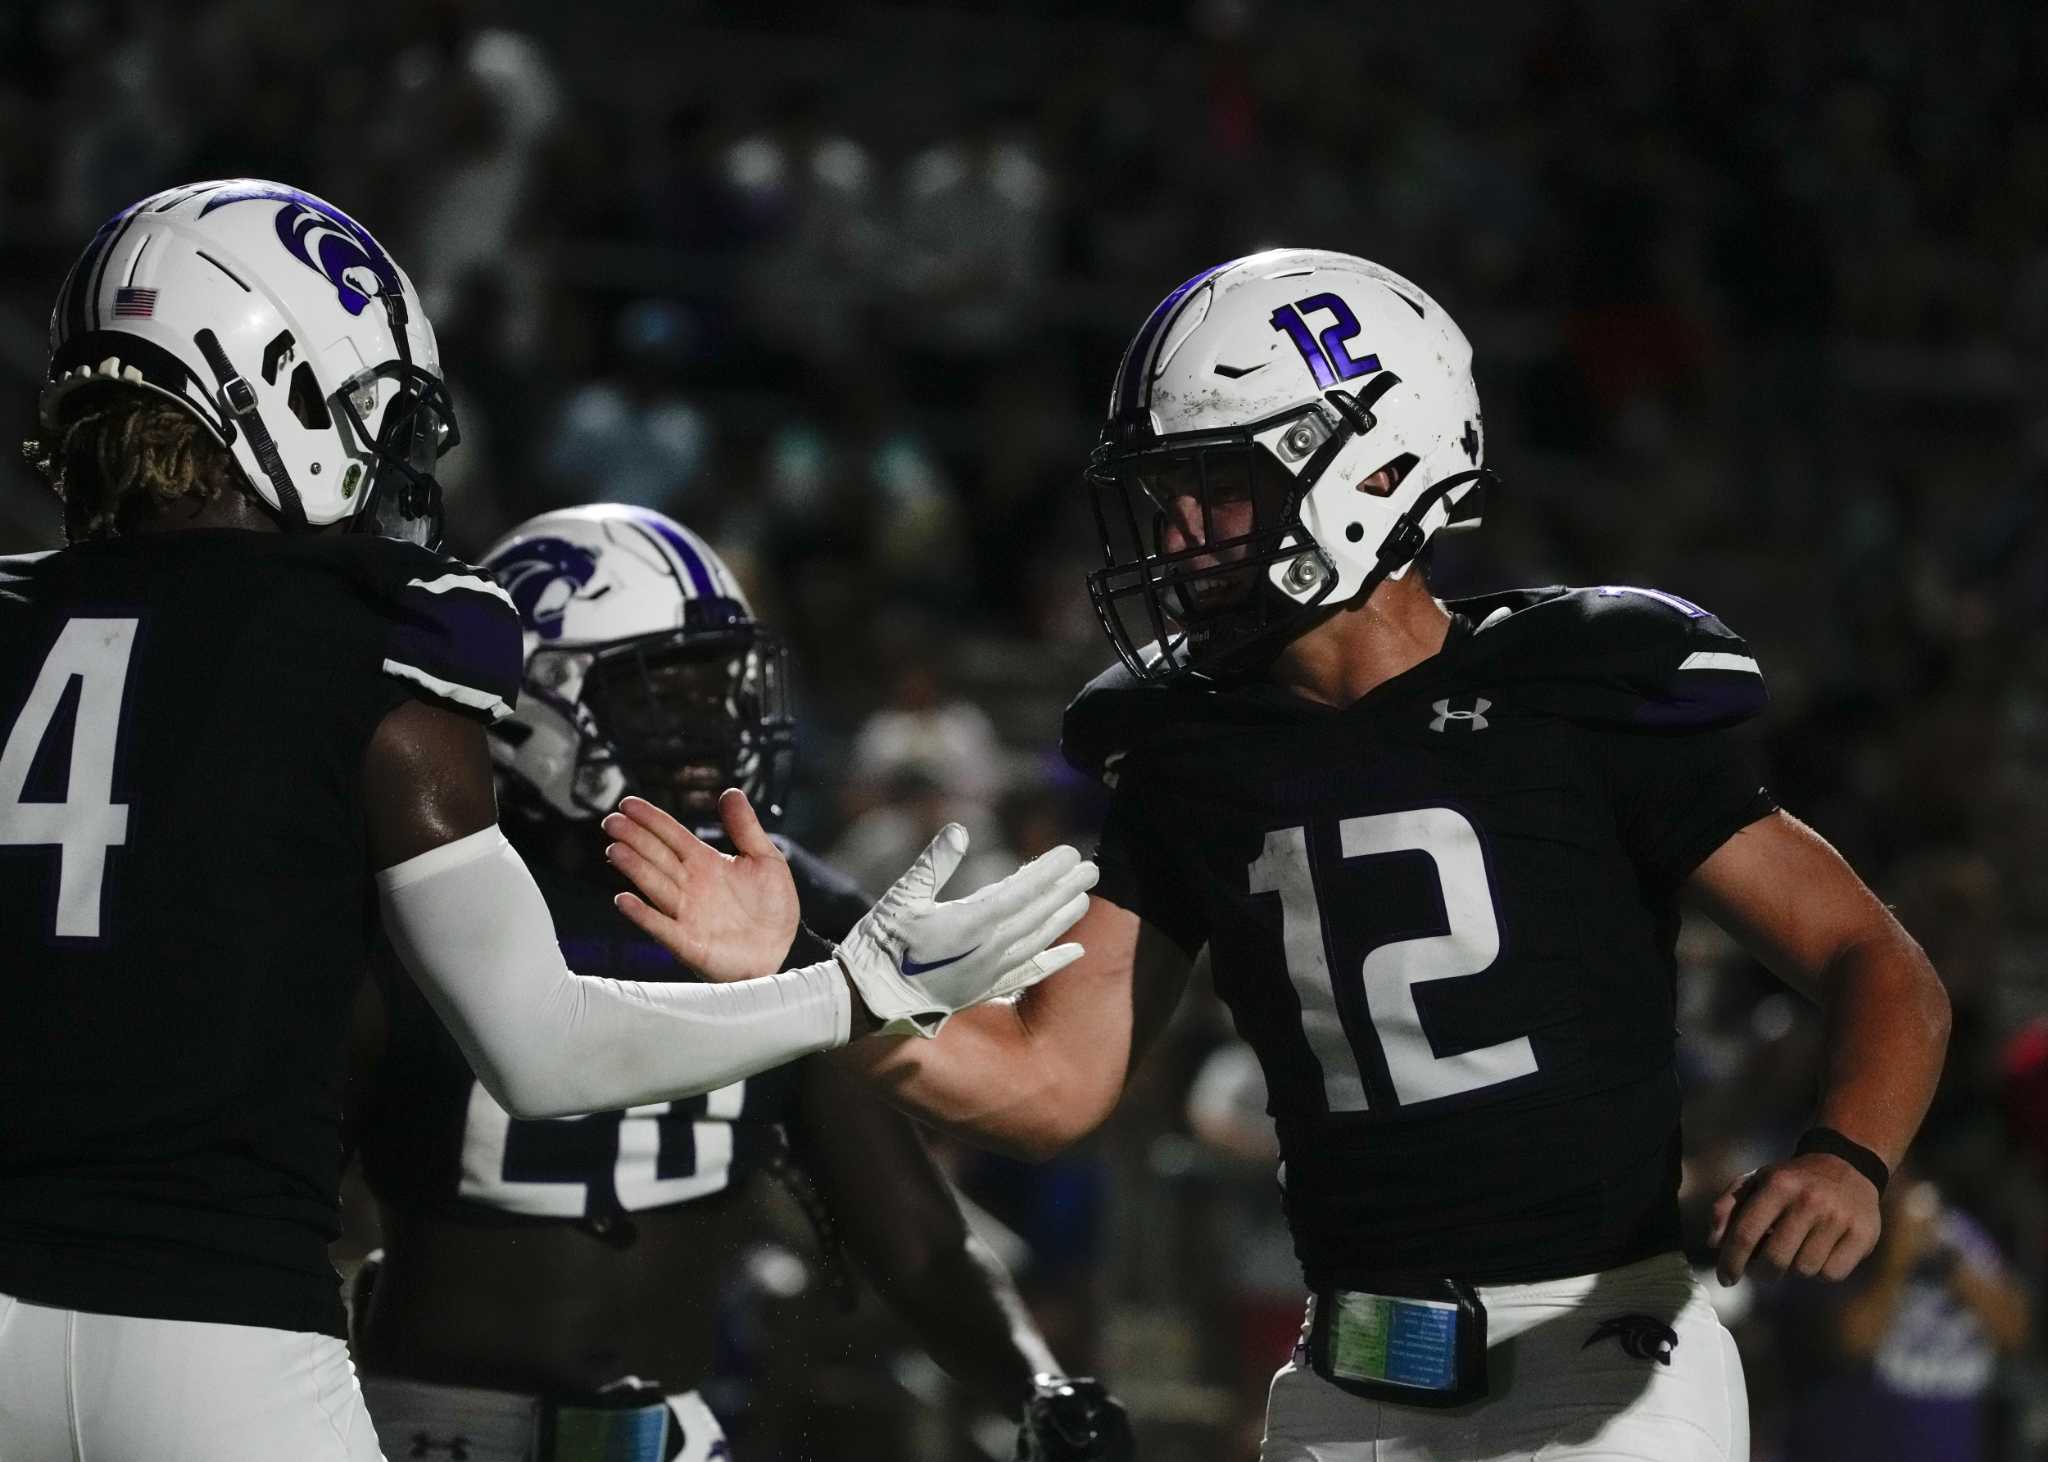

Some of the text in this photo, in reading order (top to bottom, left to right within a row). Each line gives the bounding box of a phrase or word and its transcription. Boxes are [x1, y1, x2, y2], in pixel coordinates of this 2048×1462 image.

[1268, 292, 1383, 391] 12
[0, 617, 140, 938] 4
[1247, 807, 1539, 1113] 12
